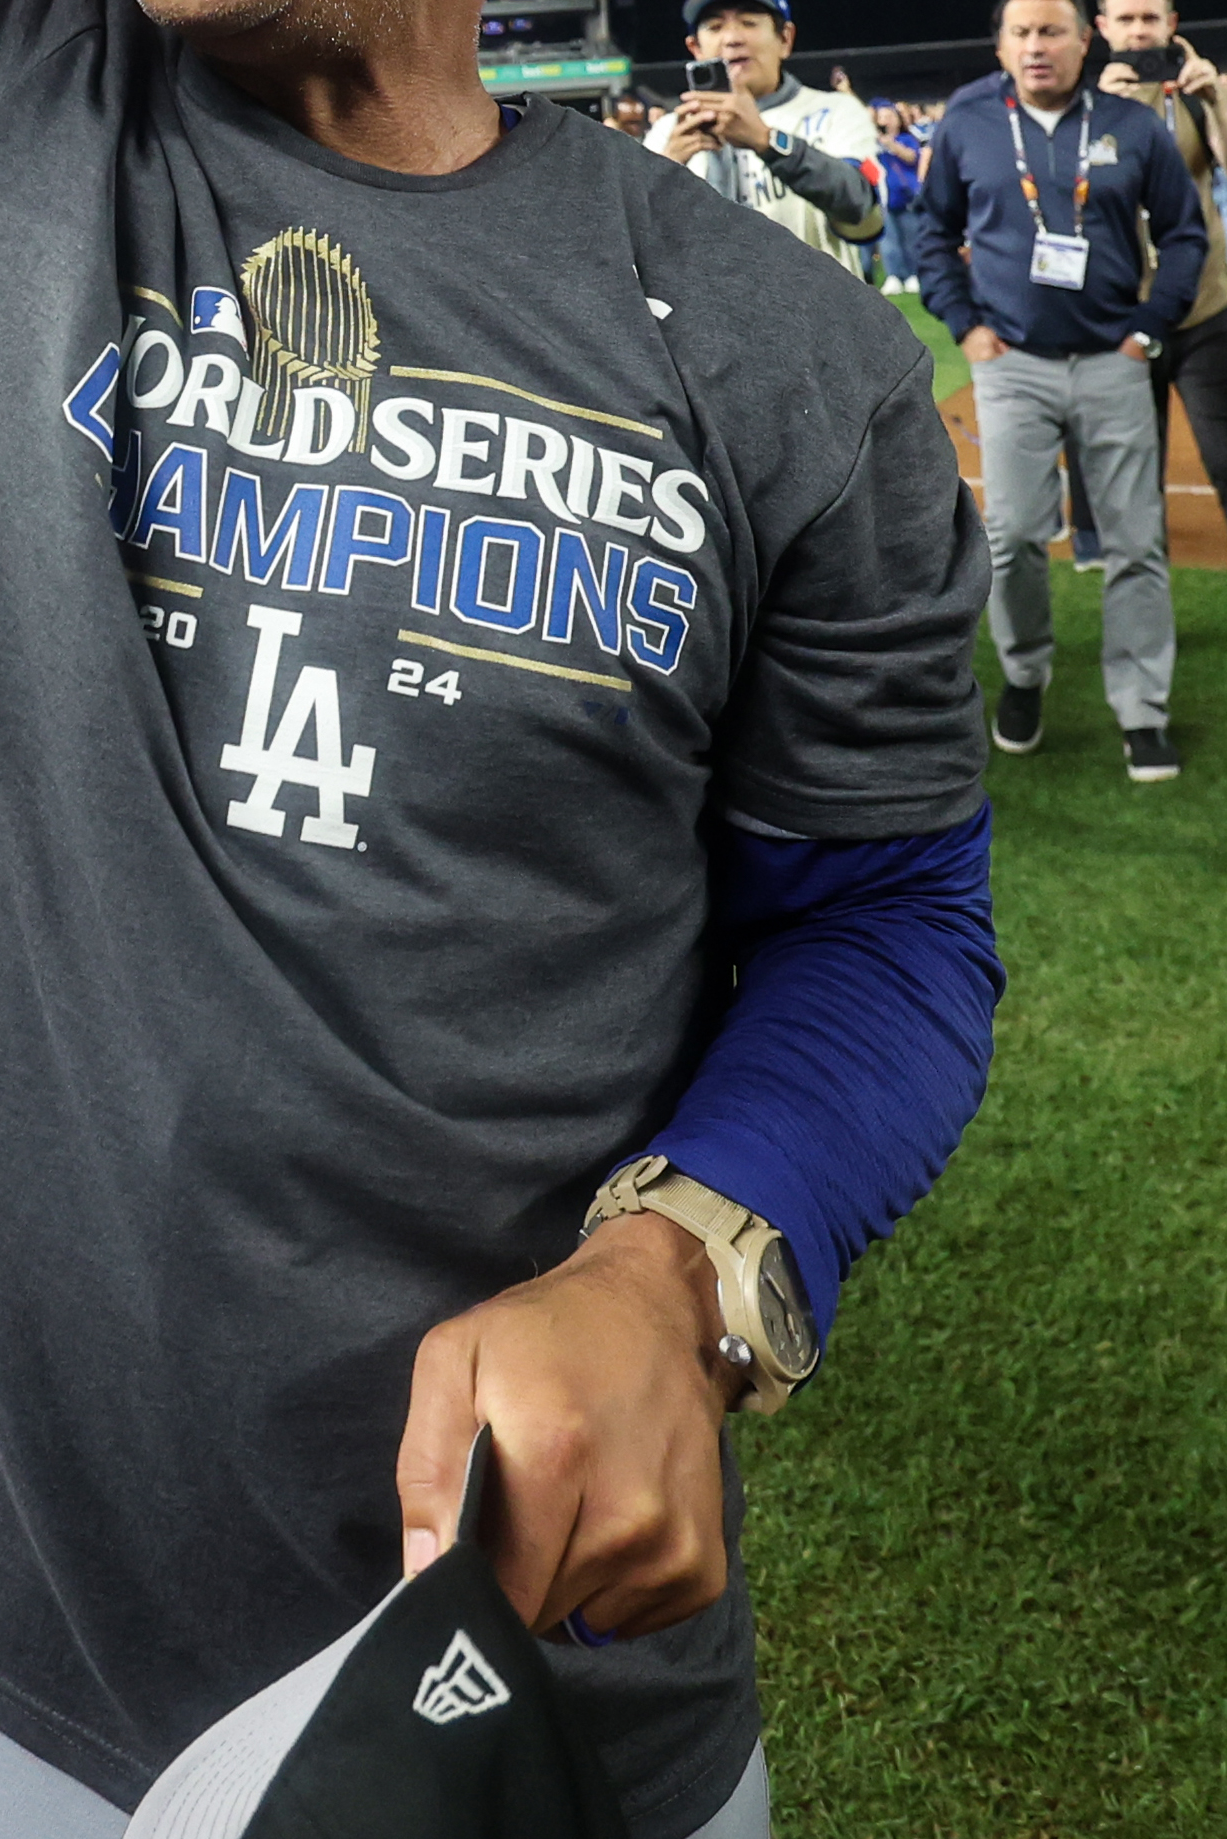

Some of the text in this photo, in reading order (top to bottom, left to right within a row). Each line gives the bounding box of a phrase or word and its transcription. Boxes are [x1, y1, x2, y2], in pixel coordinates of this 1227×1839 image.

[122, 315, 709, 554] ORLD SERIES
[220, 603, 377, 850] LA
[387, 657, 463, 706] 24
